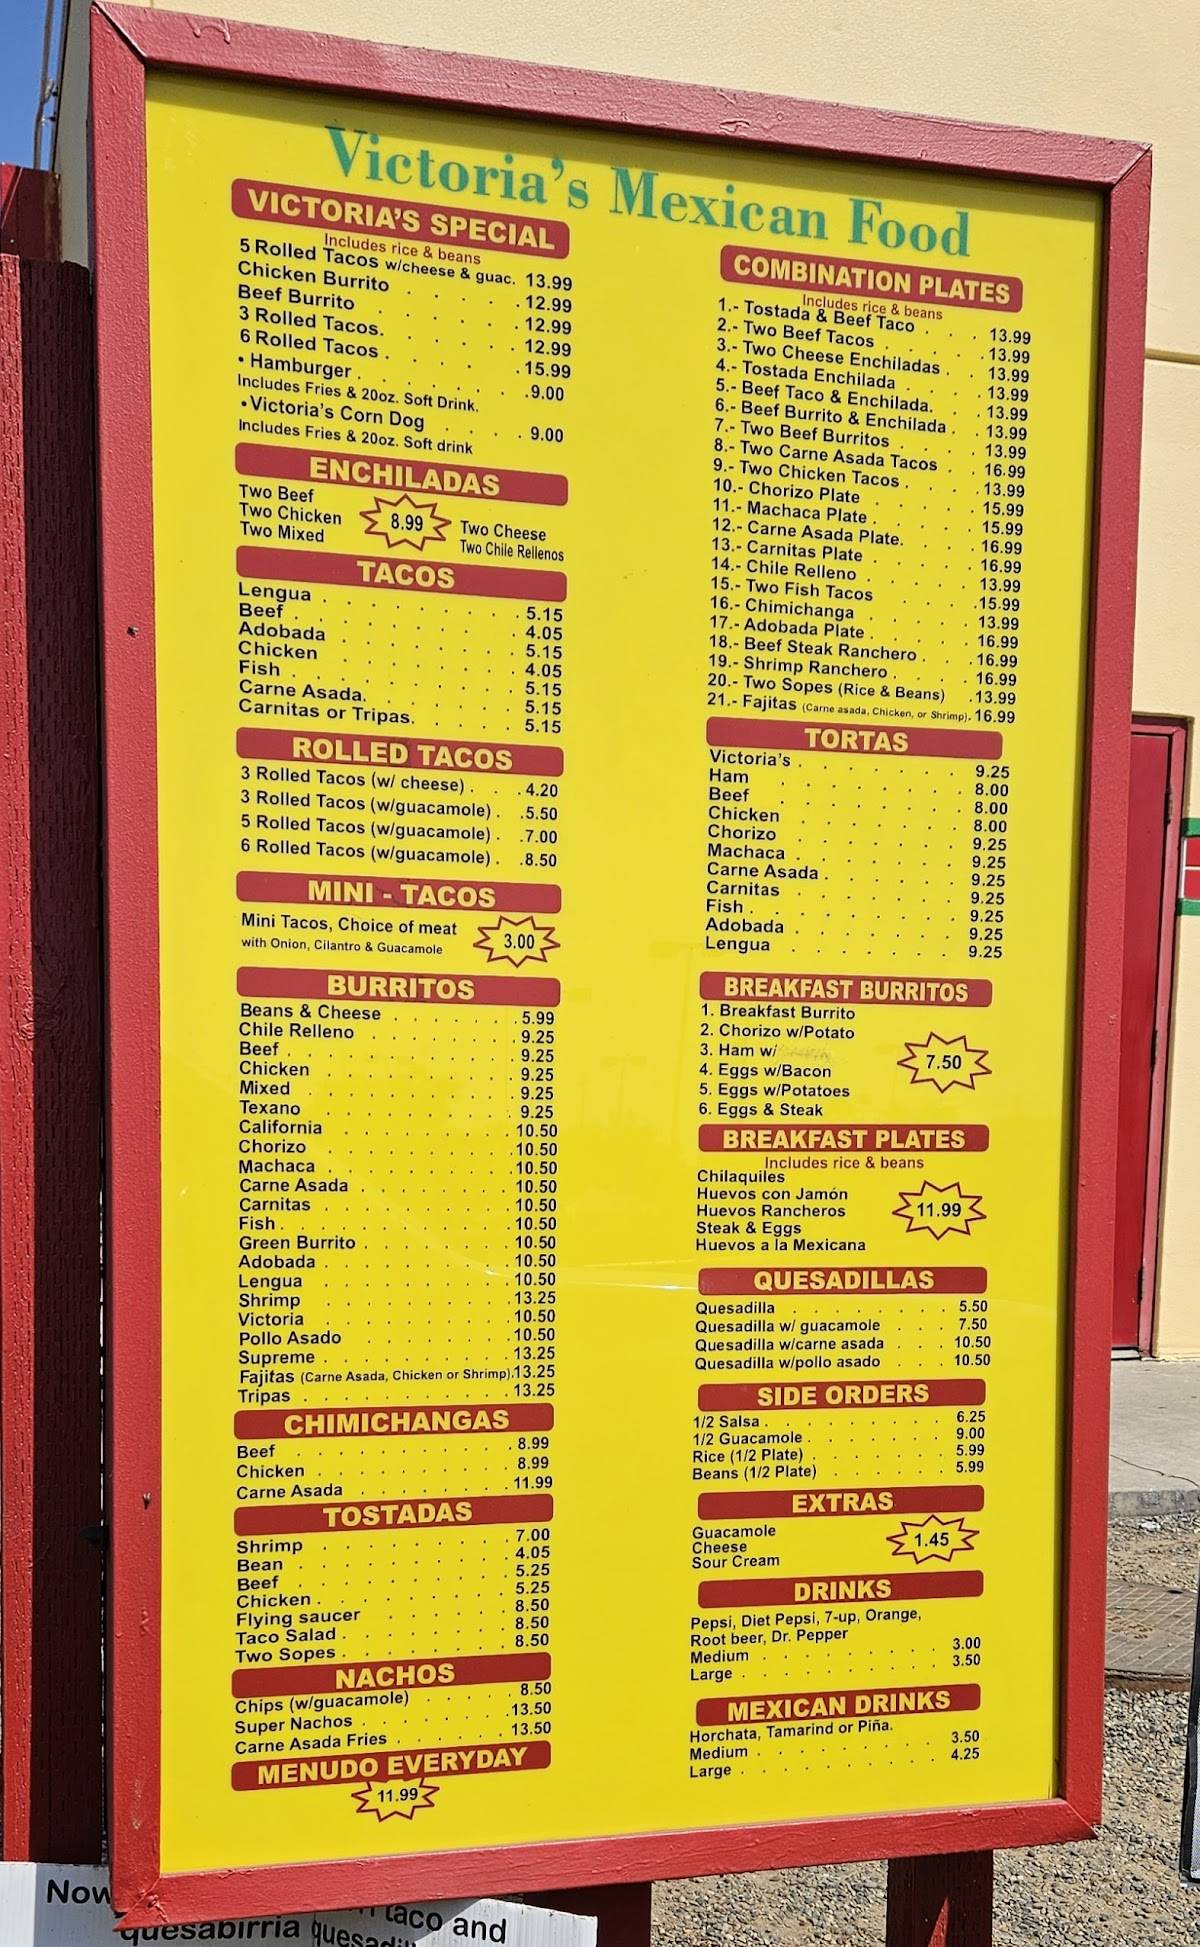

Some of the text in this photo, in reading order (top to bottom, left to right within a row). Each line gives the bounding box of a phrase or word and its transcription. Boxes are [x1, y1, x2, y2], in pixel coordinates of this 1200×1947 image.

[324, 125, 971, 257] Victoria's Mexican Food
[248, 189, 555, 250] VICTORIA'S SPECIAL
[325, 233, 481, 265] Includes rice & beans
[240, 238, 572, 291] 5 Rolled Tacos w/cheese & guac. 13.99
[238, 261, 572, 313] Chicken Burrito 12.99
[734, 254, 1010, 304] COMBINATION PLATES
[803, 294, 943, 320] Includes rice & beans
[743, 340, 776, 357] Two
[782, 345, 844, 364] Cheese
[850, 352, 940, 374] Enchiladas
[989, 366, 1029, 383] 13.99
[239, 419, 472, 454] Includes Fries & 20oz. Soft drink
[310, 456, 500, 496] ENCHILADAS
[749, 481, 813, 499] Chorizo
[820, 487, 860, 503] Plate
[984, 501, 1024, 517] 15.99
[239, 502, 341, 525] Two Chicken
[391, 513, 423, 532] 8.99
[460, 520, 546, 541] Two Cheese
[460, 539, 564, 562] Two Chile Rellenos
[357, 560, 455, 589] TACOS
[239, 582, 563, 622] Lengua 5.15
[746, 598, 854, 622] Chimichanga
[979, 615, 1019, 630] 13.99
[239, 621, 562, 659] Adobada 5.15
[804, 728, 908, 752] TORTAS
[293, 737, 512, 771] ROLLED TACOS
[241, 766, 558, 797] 3 Rolled Tacos (w/ cheese) 4.20
[710, 768, 1008, 797] Ham 8.00
[708, 843, 1006, 869] Machaca 9.25
[308, 880, 373, 903] MINI
[400, 884, 496, 908] TACOS
[242, 912, 456, 935] Mini Tacos, Choice of meat
[242, 937, 442, 954] with Onion, Cilantro & Guacamole
[504, 933, 535, 949] 3.00
[328, 975, 474, 1000] BURRITOS
[725, 977, 968, 1002] BREAKFAST BURRITOS
[241, 1003, 554, 1025] Beans & Cheese 5.99
[239, 1022, 554, 1044] Chile Relleno 9.25
[700, 1023, 854, 1039] 2. Chorizo w/Potato
[926, 1054, 961, 1069] 7.50
[239, 1119, 557, 1137] California 10.50
[723, 1130, 965, 1149] BREAKFAST PLATES
[697, 1169, 785, 1186] Chilaquiles
[697, 1187, 848, 1200] Huevos con Jamón
[917, 1202, 961, 1217] 11.99
[754, 1267, 934, 1291] QUESADILLAS
[240, 1328, 555, 1346] Pollo Asado 10.50
[695, 1336, 991, 1352] Quesadilla w/carne asada 10.50
[757, 1384, 929, 1406] SIDE ORDERS
[284, 1410, 509, 1435] CHIMICHANGAS
[693, 1443, 984, 1465] Rice (1/2 Plate) 5.99
[237, 1456, 549, 1478] Chicken 8.99
[323, 1502, 472, 1527] TOSTADAS
[792, 1492, 893, 1513] EXTRAS
[914, 1532, 949, 1547] 1.45
[692, 1555, 779, 1569] Sour Cream
[795, 1579, 891, 1601] DRINKS
[237, 1598, 549, 1629] Flying saucer 8.50
[691, 1609, 922, 1634] Pepsi, Diet Pepsi, 7-up, Orange,
[336, 1663, 455, 1689] NACHOS
[235, 1682, 551, 1715] Chips (w/guacamole) 8.50
[728, 1691, 950, 1721] MEXICAN DRINKS
[690, 1719, 894, 1745] Horchata, Tamarind or Piña.
[690, 1730, 979, 1760] Medium 3.50
[258, 1747, 527, 1784] MENUDO EVERYDAY
[378, 1788, 418, 1802] 11.99
[453, 1918, 506, 1944] and
